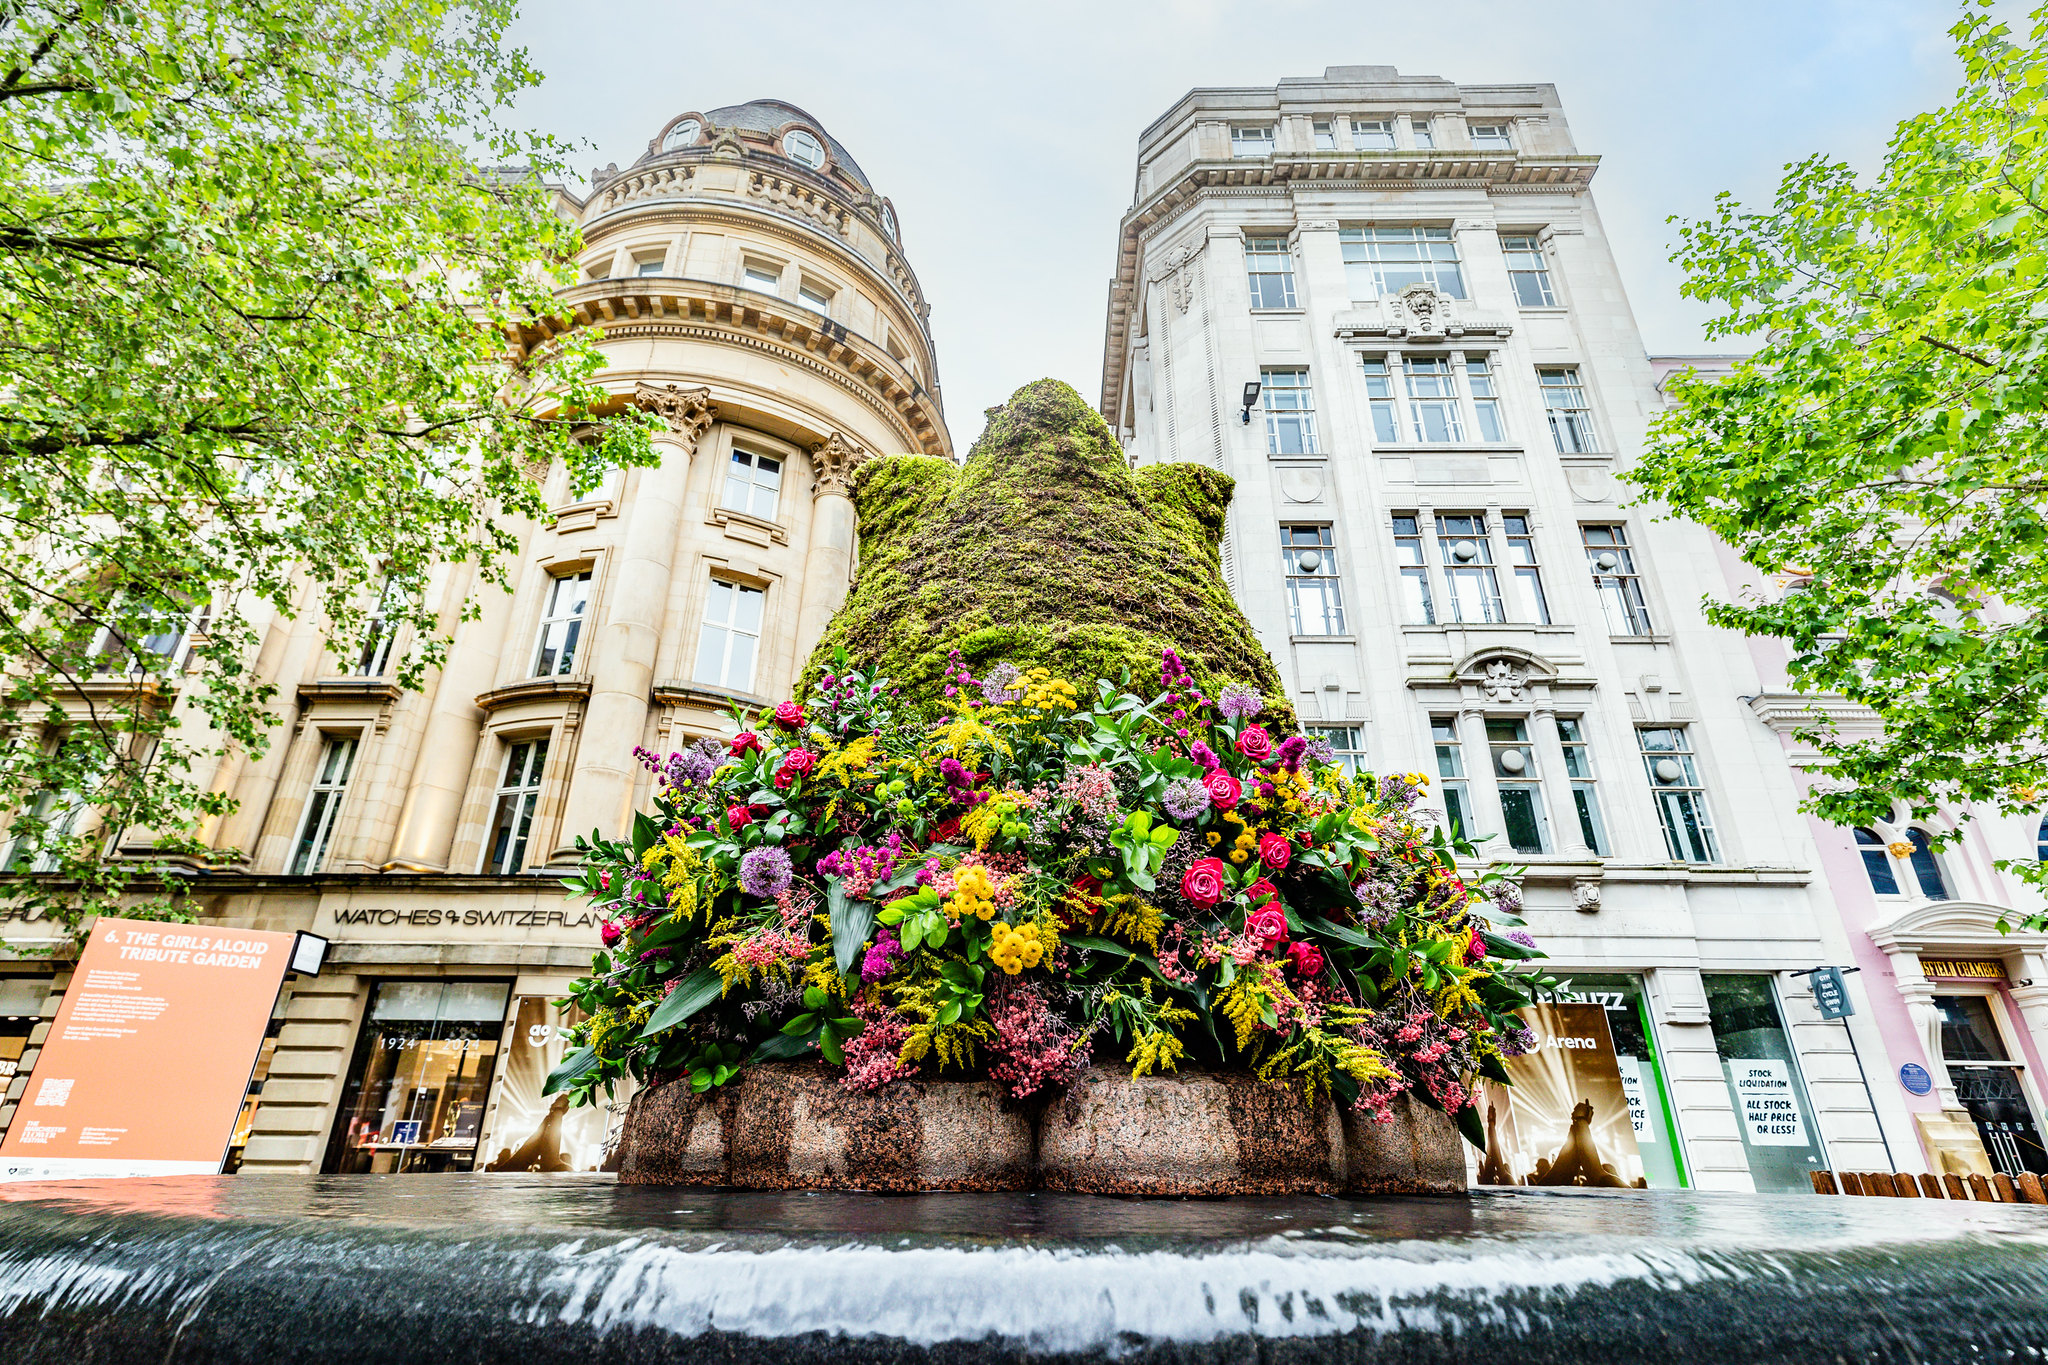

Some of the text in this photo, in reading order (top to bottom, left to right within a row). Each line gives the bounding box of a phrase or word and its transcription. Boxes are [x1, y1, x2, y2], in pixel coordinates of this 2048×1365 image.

[334, 909, 442, 925] WATCHES
[463, 909, 610, 928] SWITZERLAN
[104, 930, 268, 955] 6. THE GIRLS ALOUD
[119, 946, 261, 969] TRIBUTE GARDEN
[1920, 961, 2006, 978] SFIELD CHAMBERS
[1822, 990, 1839, 998] CYCLE
[380, 1037, 416, 1050] 1924
[443, 1038, 480, 1050] 2024
[1546, 1035, 1597, 1049] Arena
[1749, 1069, 1772, 1077] STOCK
[1739, 1080, 1787, 1088] LIQUIDATION
[1747, 1100, 1792, 1110] ALL STOCK
[1748, 1112, 1797, 1122] HALF PRICE
[1757, 1124, 1796, 1135] OR LESS!
